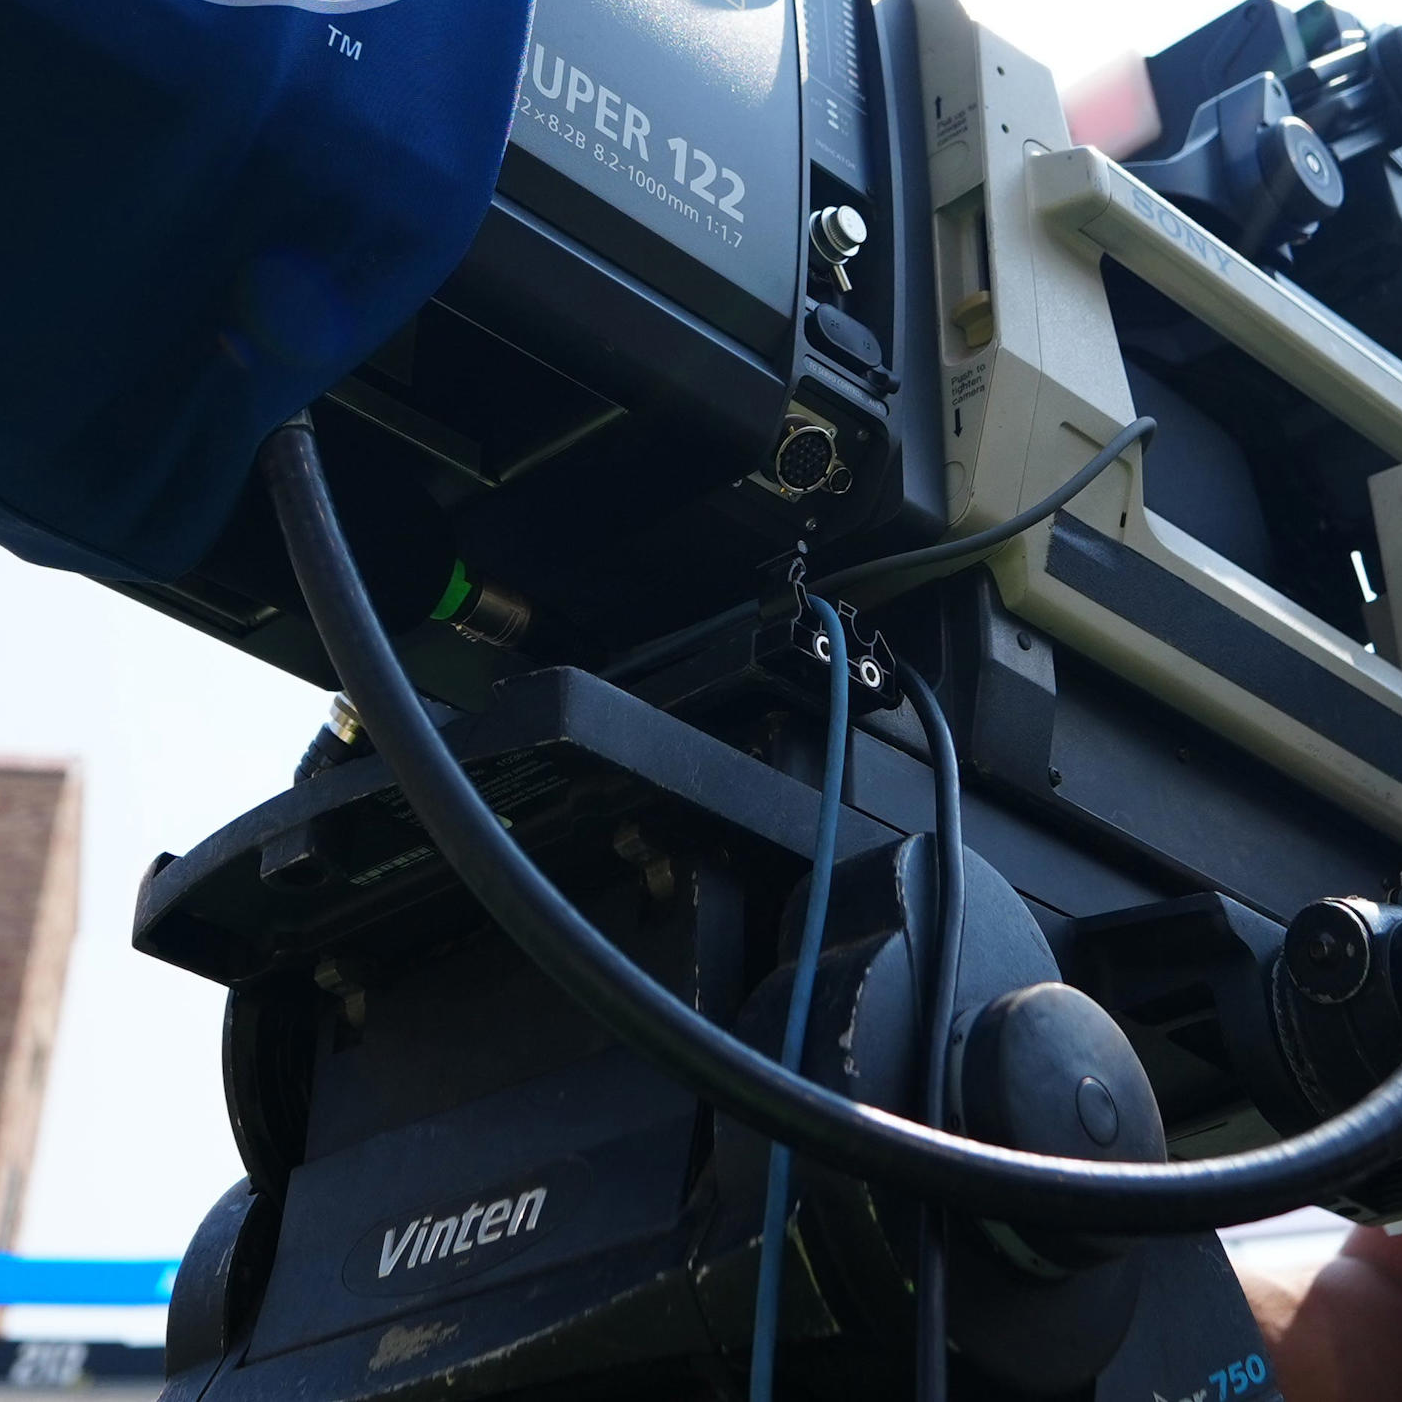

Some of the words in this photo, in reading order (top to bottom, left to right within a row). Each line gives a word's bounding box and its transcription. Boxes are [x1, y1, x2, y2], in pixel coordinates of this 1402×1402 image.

[326, 23, 364, 62] TM
[522, 42, 651, 163] UPER
[666, 136, 747, 224] 122
[593, 142, 700, 224] 8.2-1000mm
[705, 214, 744, 250] 1:1.7
[1131, 186, 1232, 274] SONY
[952, 376, 983, 396] tighten
[977, 363, 986, 373] to
[952, 384, 986, 406] camera
[377, 1186, 548, 1279] Vinten
[1208, 1353, 1267, 1402] 750
